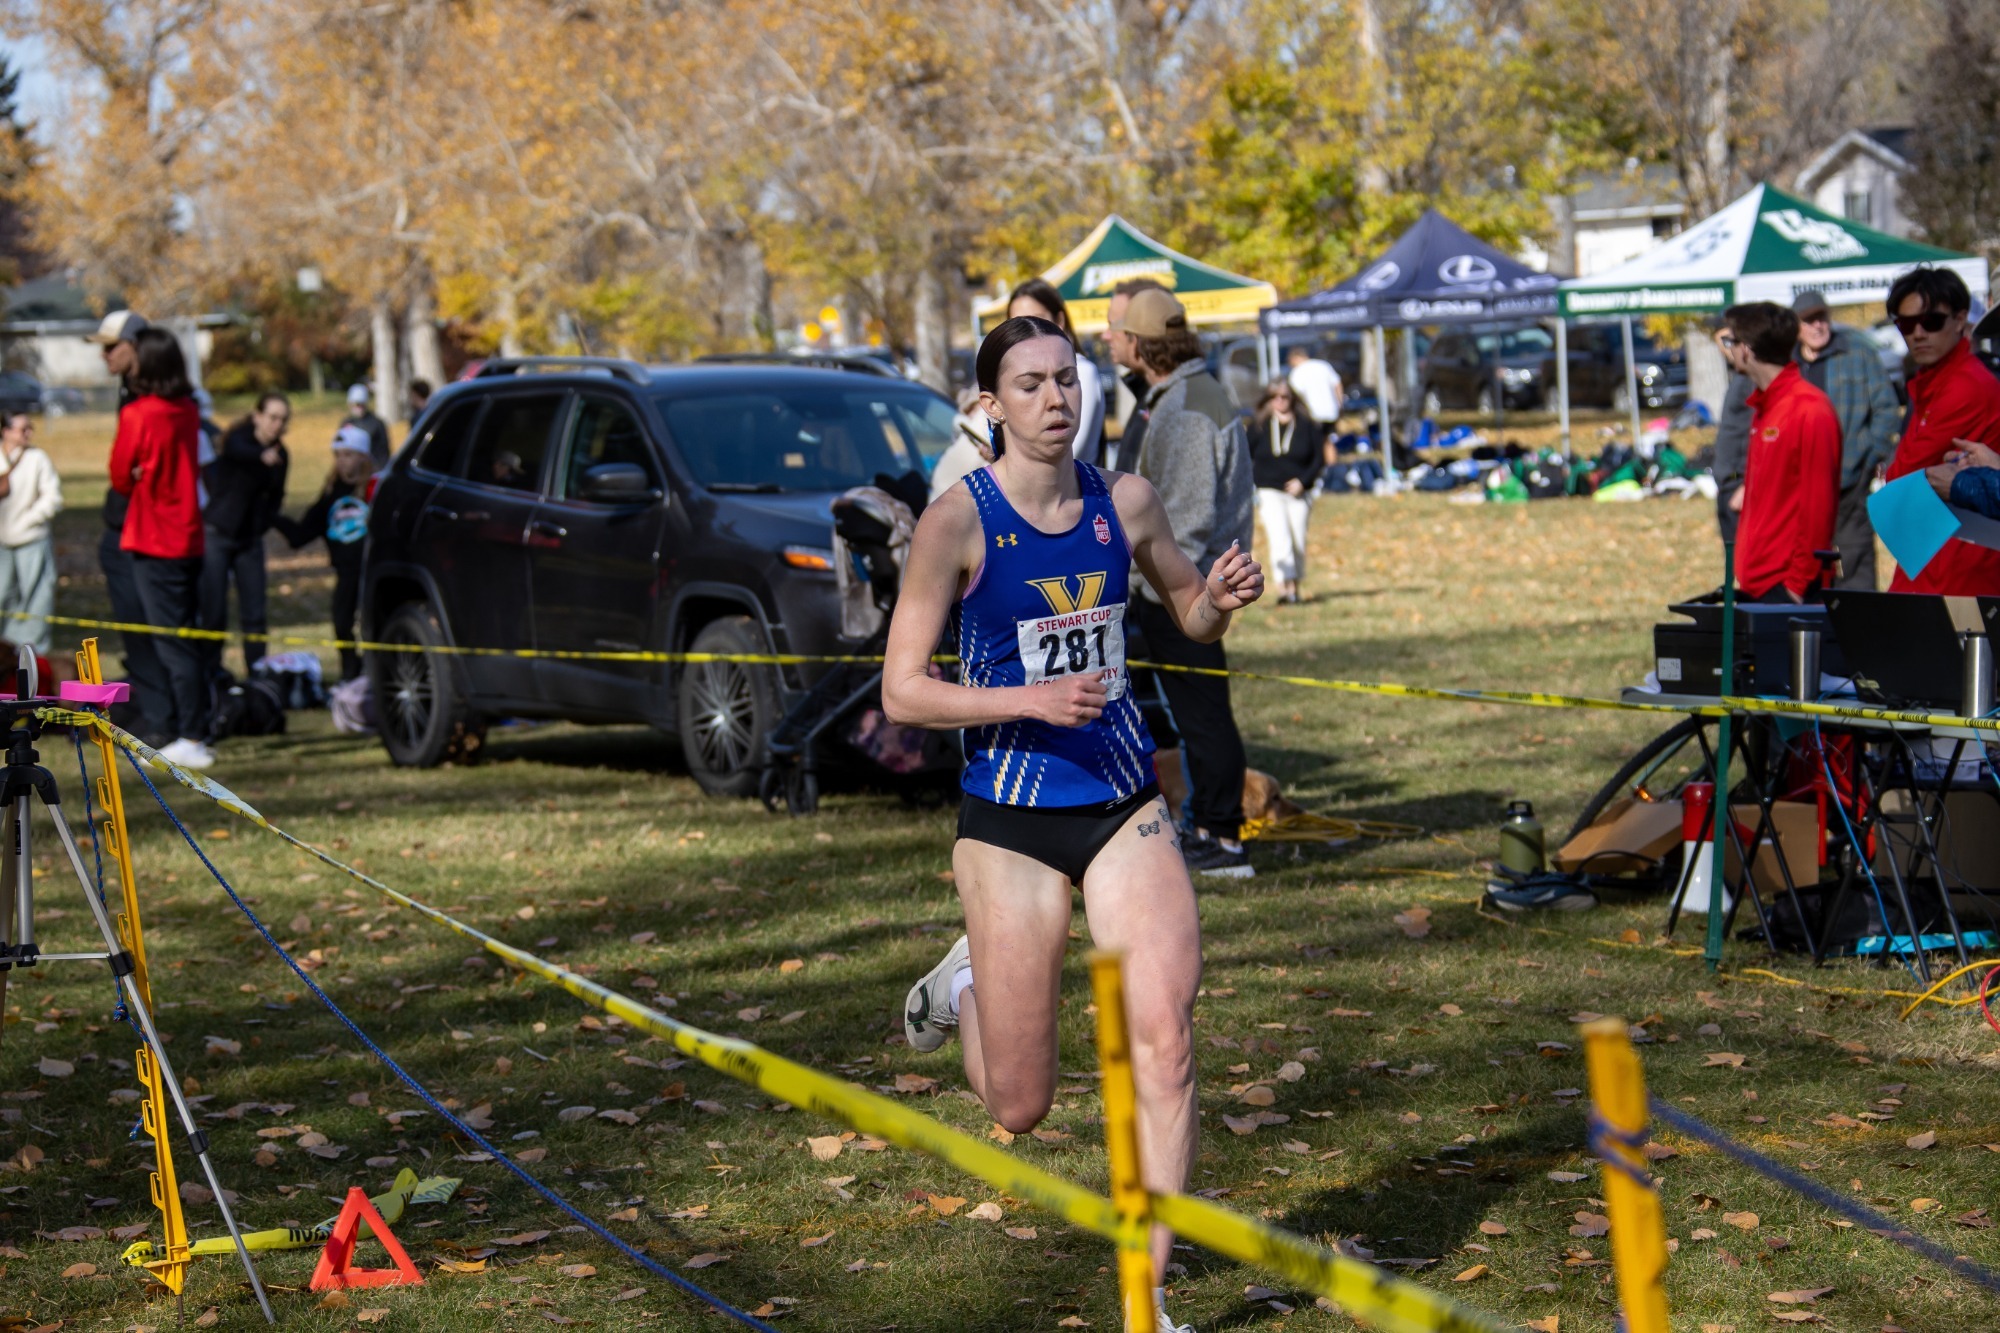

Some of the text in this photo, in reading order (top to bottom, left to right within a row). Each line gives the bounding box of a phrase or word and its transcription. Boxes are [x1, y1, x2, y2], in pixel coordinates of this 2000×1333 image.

[1024, 571, 1107, 616] V
[1037, 609, 1111, 633] STEWART CUP
[1039, 624, 1107, 677] 281
